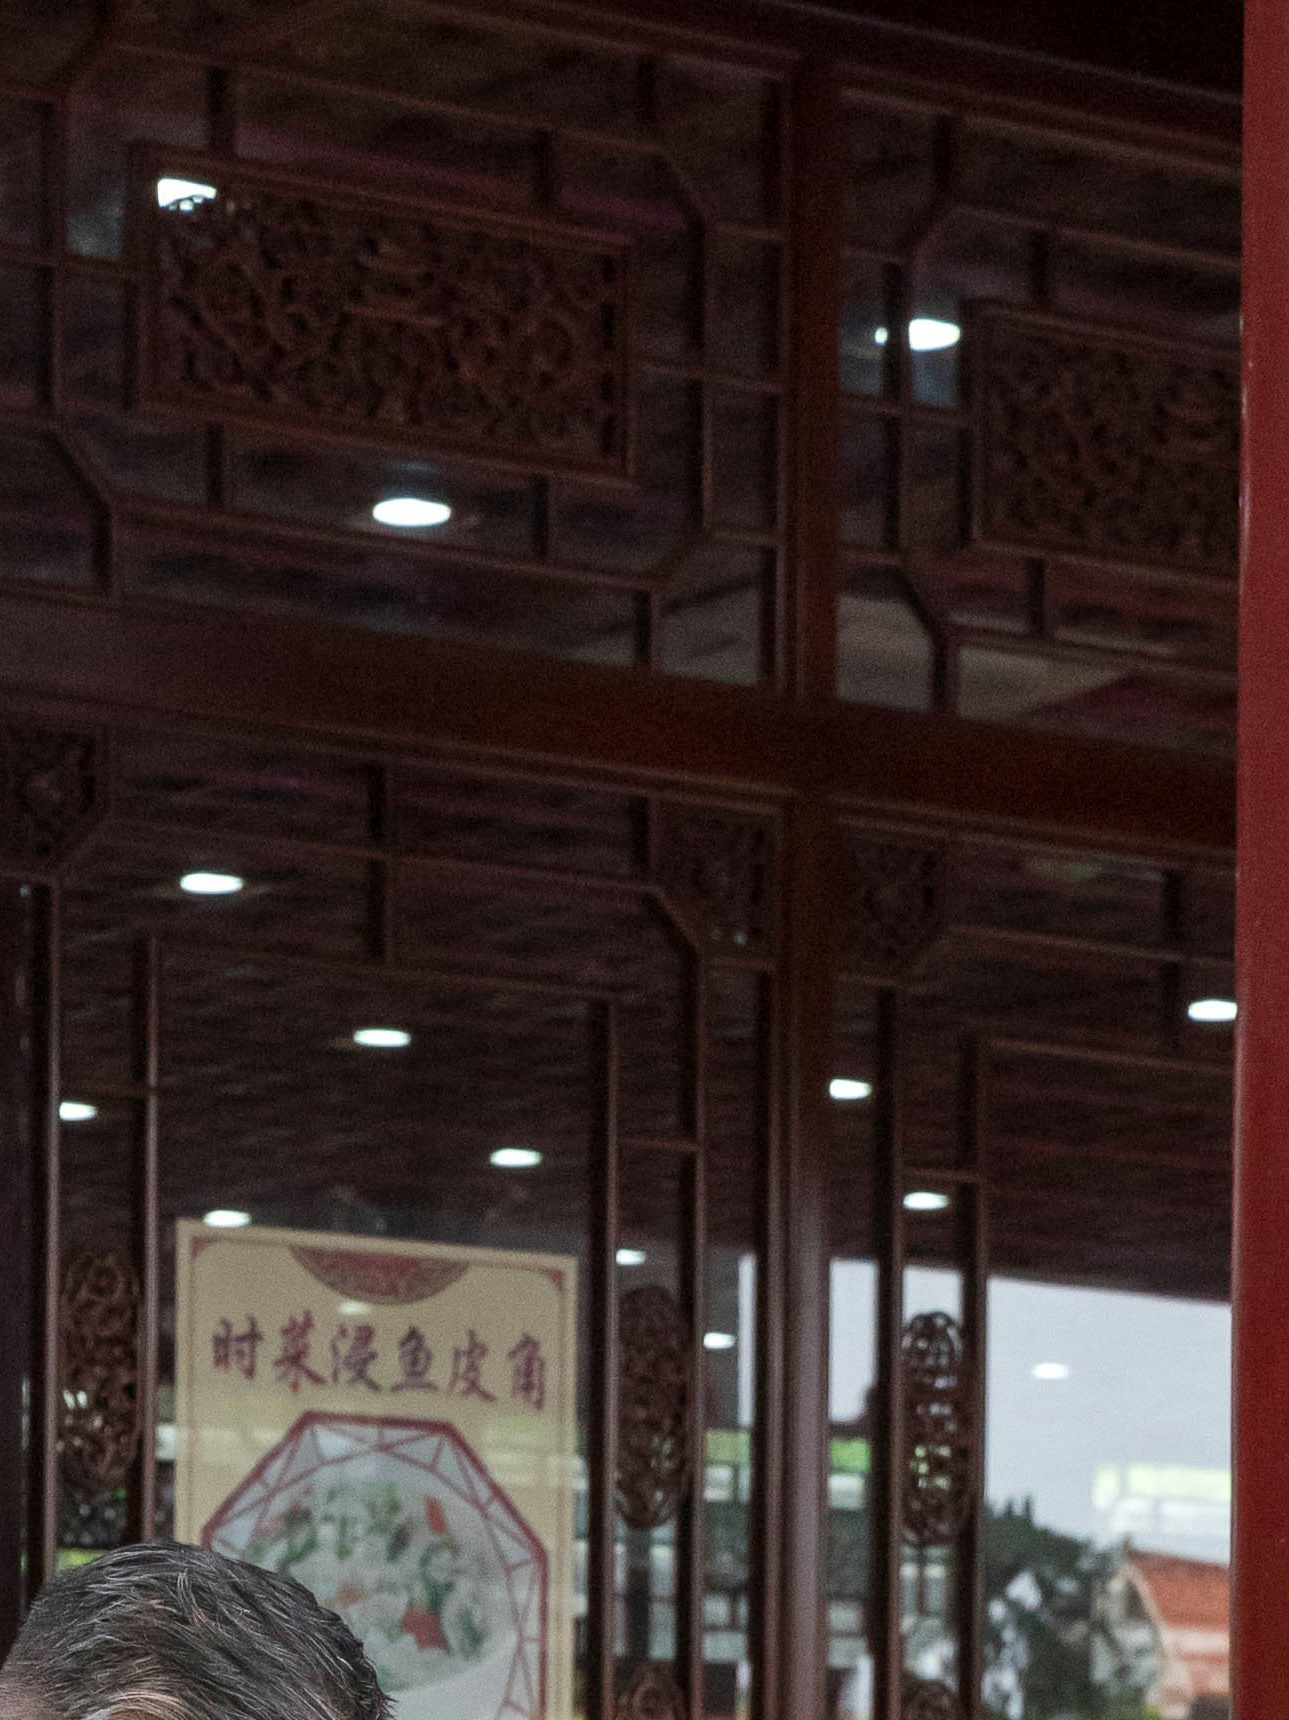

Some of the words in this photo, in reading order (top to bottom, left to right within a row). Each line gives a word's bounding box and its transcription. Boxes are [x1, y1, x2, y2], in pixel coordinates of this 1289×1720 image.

[211, 1310, 547, 1410] 时菜浸鱼皮角
